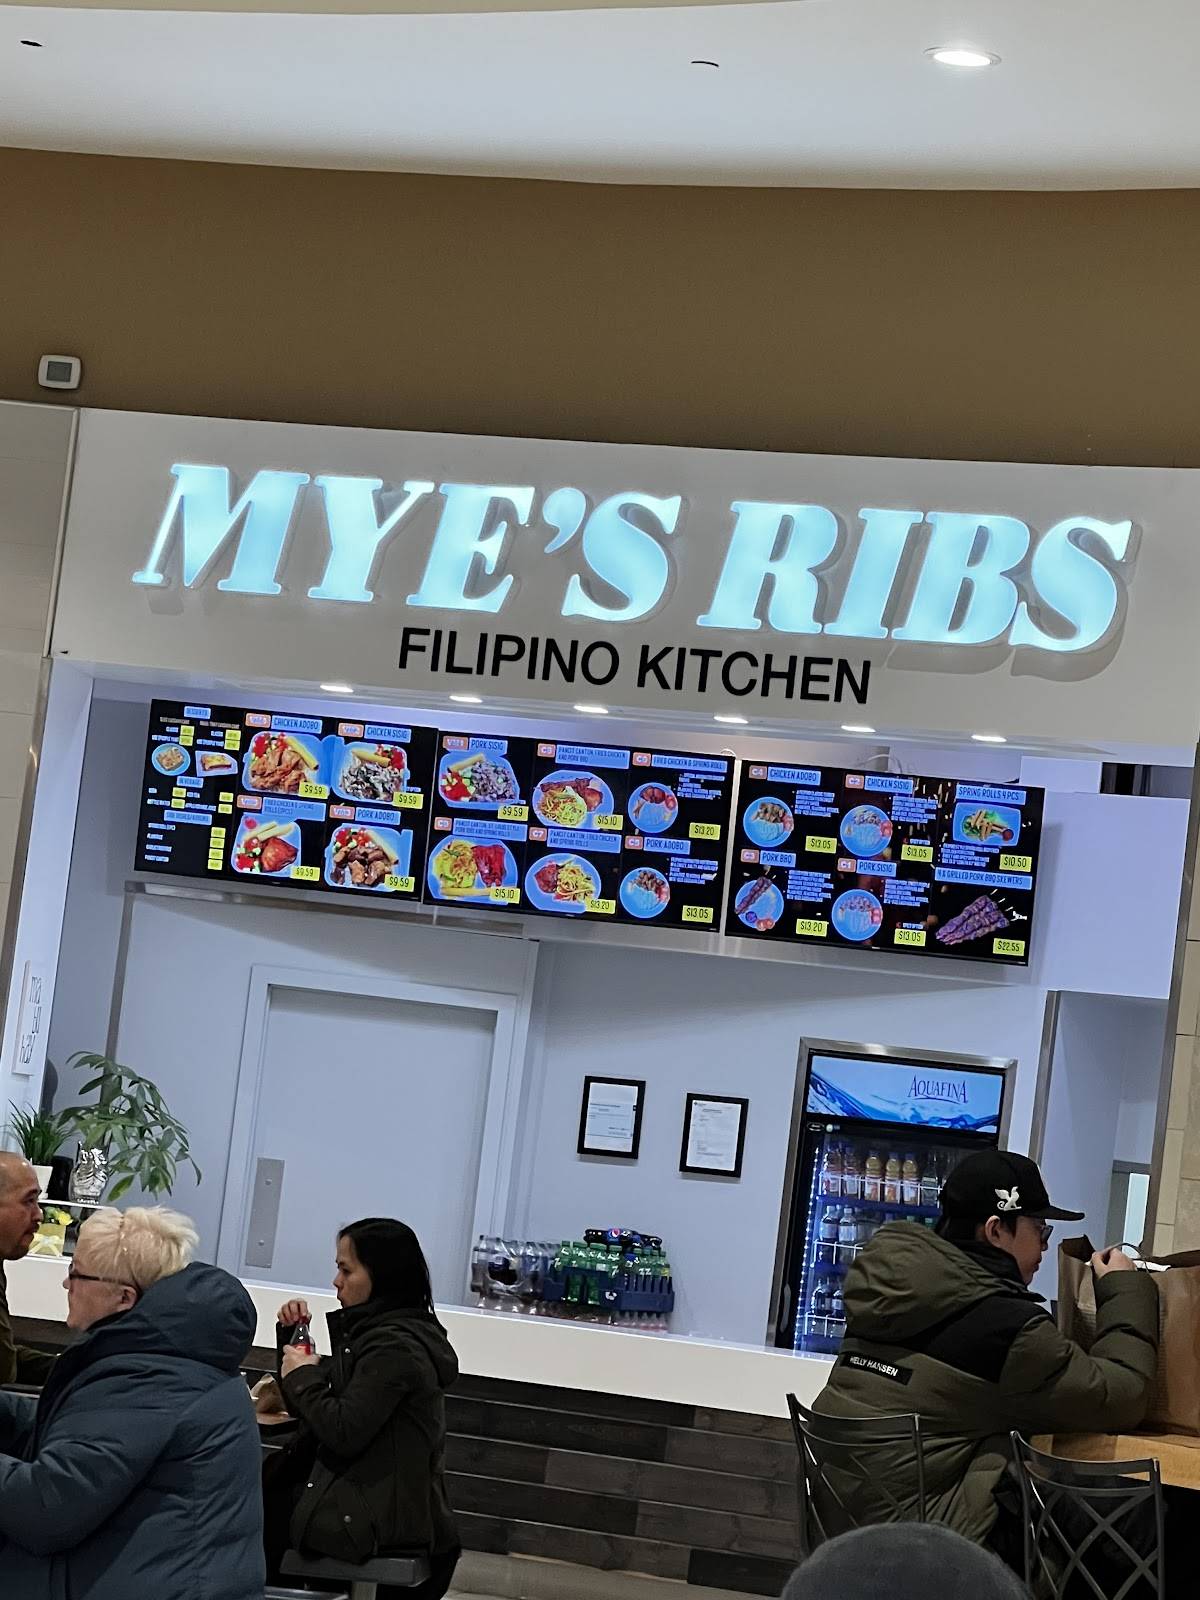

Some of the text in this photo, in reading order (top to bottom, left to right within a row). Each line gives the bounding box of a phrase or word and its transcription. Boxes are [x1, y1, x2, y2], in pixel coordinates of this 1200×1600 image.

[131, 463, 1133, 651] MYE'S RIBS
[399, 627, 871, 704] FILIPINO KITCHEN
[273, 717, 298, 727] CHICKEN
[298, 720, 319, 730] ADOBO
[367, 726, 392, 736] CHICKEN
[471, 739, 486, 749] PORK
[487, 741, 504, 751] SISIG
[770, 769, 817, 782] CHICKEN ADOBO
[867, 777, 909, 790] CHICKEN SISIG
[958, 786, 981, 797] SPRING
[982, 788, 1001, 799] ROLLS
[374, 810, 395, 821] ADOBO
[502, 806, 523, 817] $9.59
[646, 839, 662, 848] PORK
[762, 852, 778, 862] PORK
[1003, 856, 1027, 868] $10.50
[859, 861, 893, 873] PORK SISIG
[495, 888, 515, 899] $15.10
[907, 1074, 969, 1104] AQUAFINA
[866, 1359, 899, 1377] HANSEN
